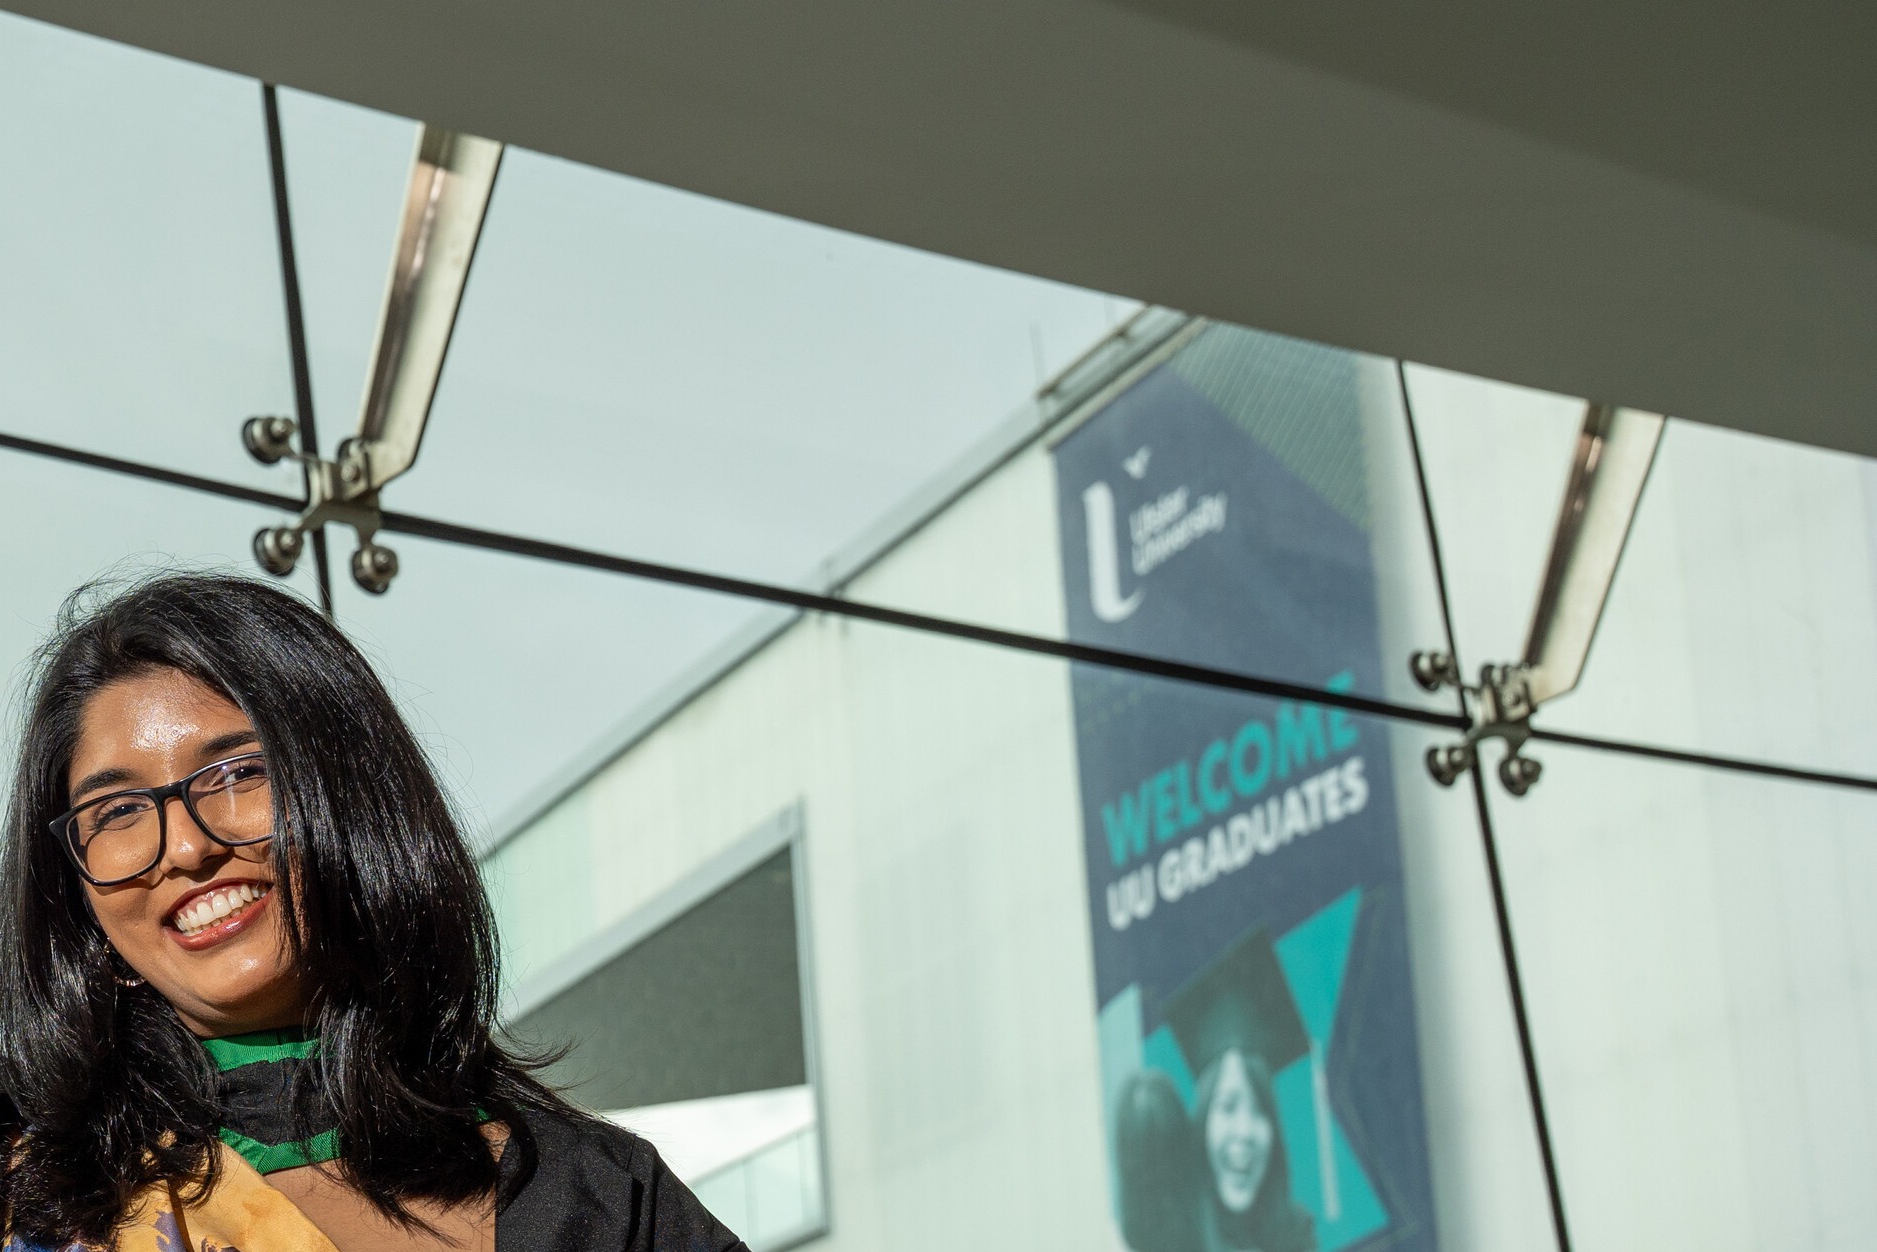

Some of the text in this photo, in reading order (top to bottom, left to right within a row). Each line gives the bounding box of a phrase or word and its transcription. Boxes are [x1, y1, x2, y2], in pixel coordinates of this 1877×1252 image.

[1102, 666, 1360, 868] WELCOME
[1106, 755, 1369, 931] UU GRADUATES
